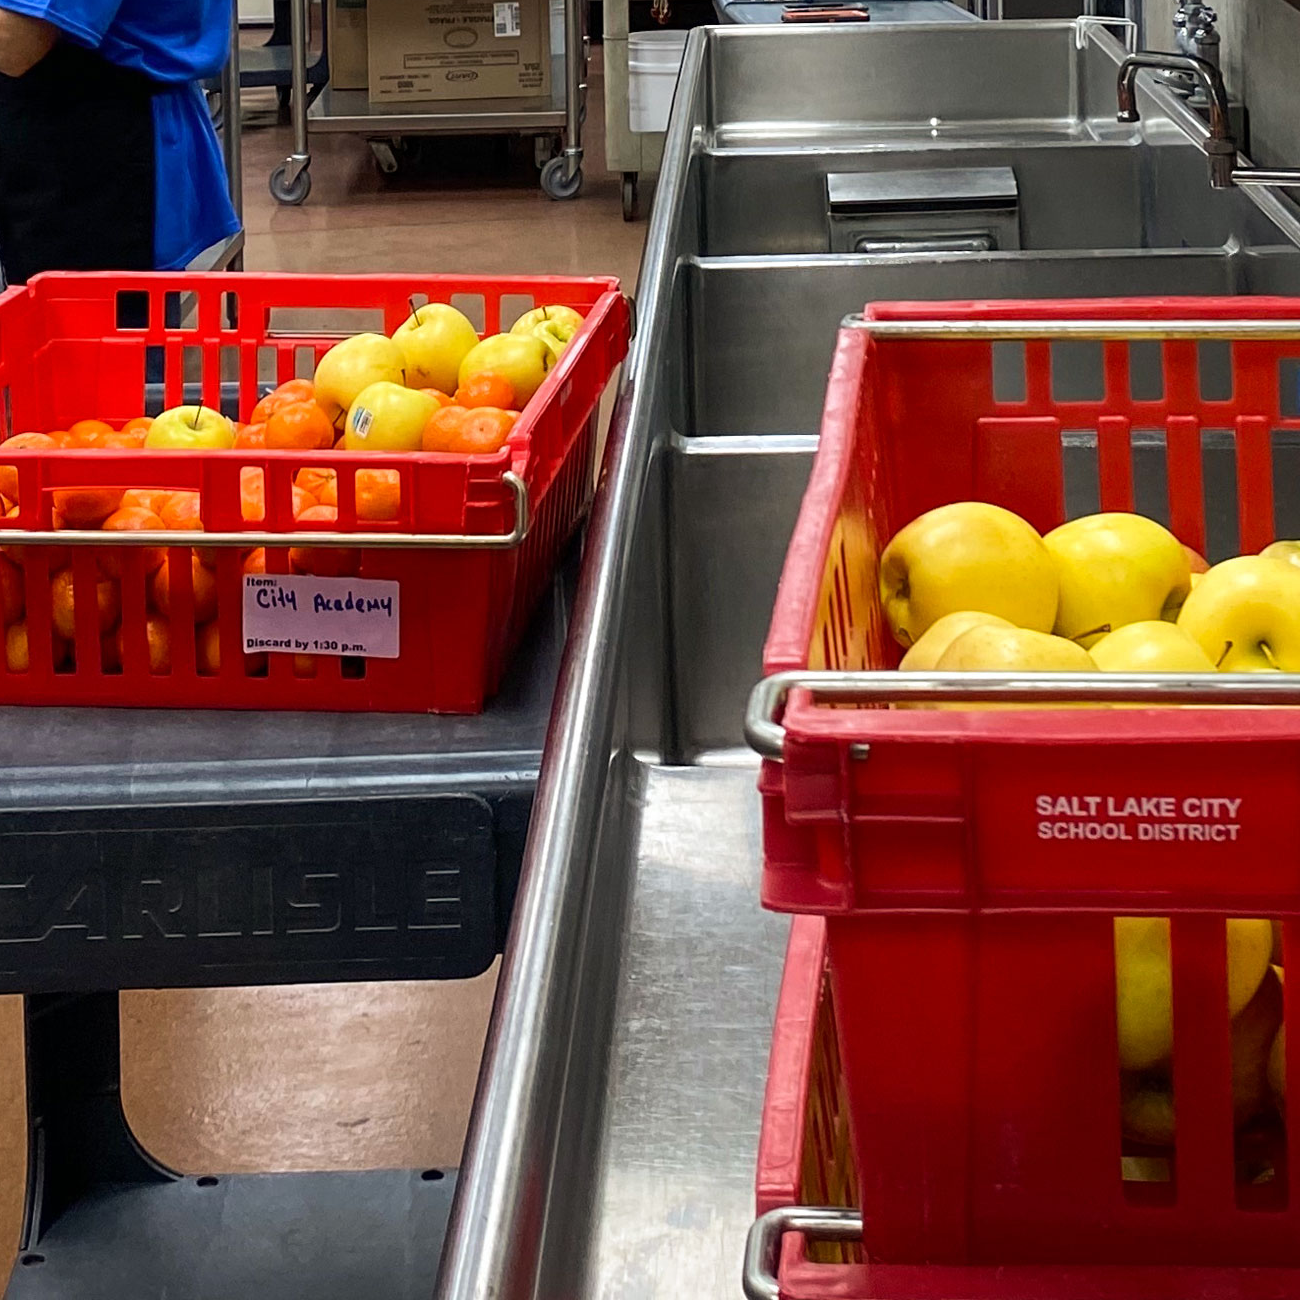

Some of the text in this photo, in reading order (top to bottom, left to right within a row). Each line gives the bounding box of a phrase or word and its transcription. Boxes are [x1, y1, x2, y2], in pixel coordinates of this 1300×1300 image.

[246, 577, 278, 587] Item:
[256, 588, 297, 612] City
[246, 638, 367, 654] Discard by 1:30 p.m.
[1036, 796, 1242, 818] SALT LAKE CITY
[1037, 820, 1240, 842] SCHOOL DISTRICT
